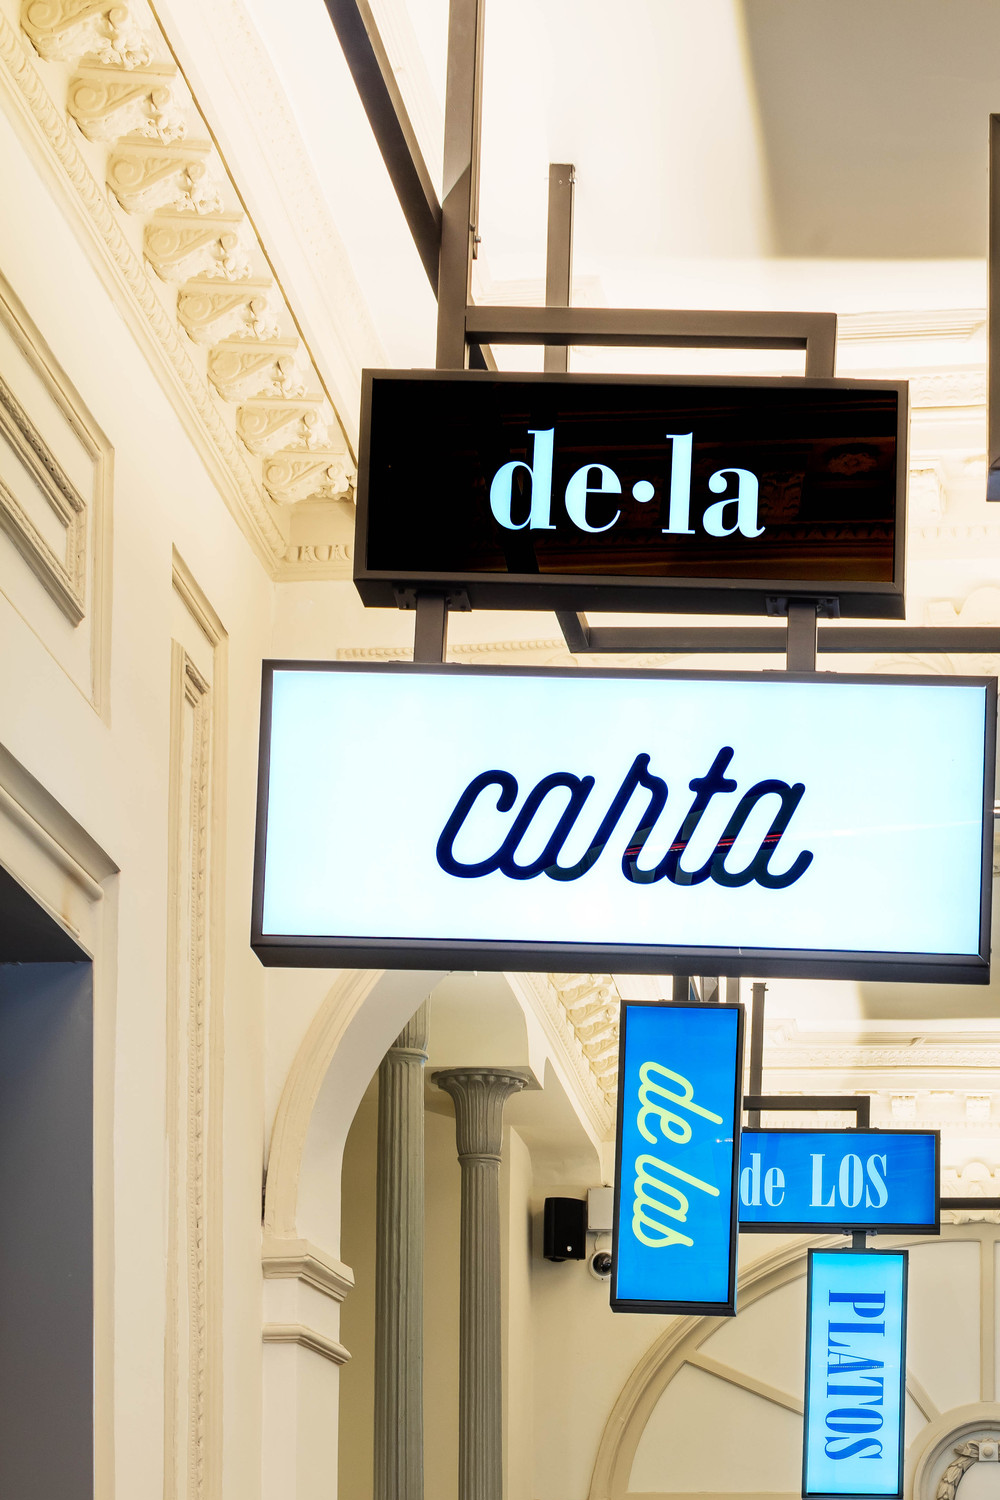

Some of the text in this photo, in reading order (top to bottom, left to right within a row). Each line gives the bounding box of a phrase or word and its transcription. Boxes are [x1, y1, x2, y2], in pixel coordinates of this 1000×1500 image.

[436, 746, 814, 890] carta
[632, 1061, 724, 1248] de las
[740, 1152, 889, 1209] de LOS
[825, 1290, 886, 1460] PLATOS
